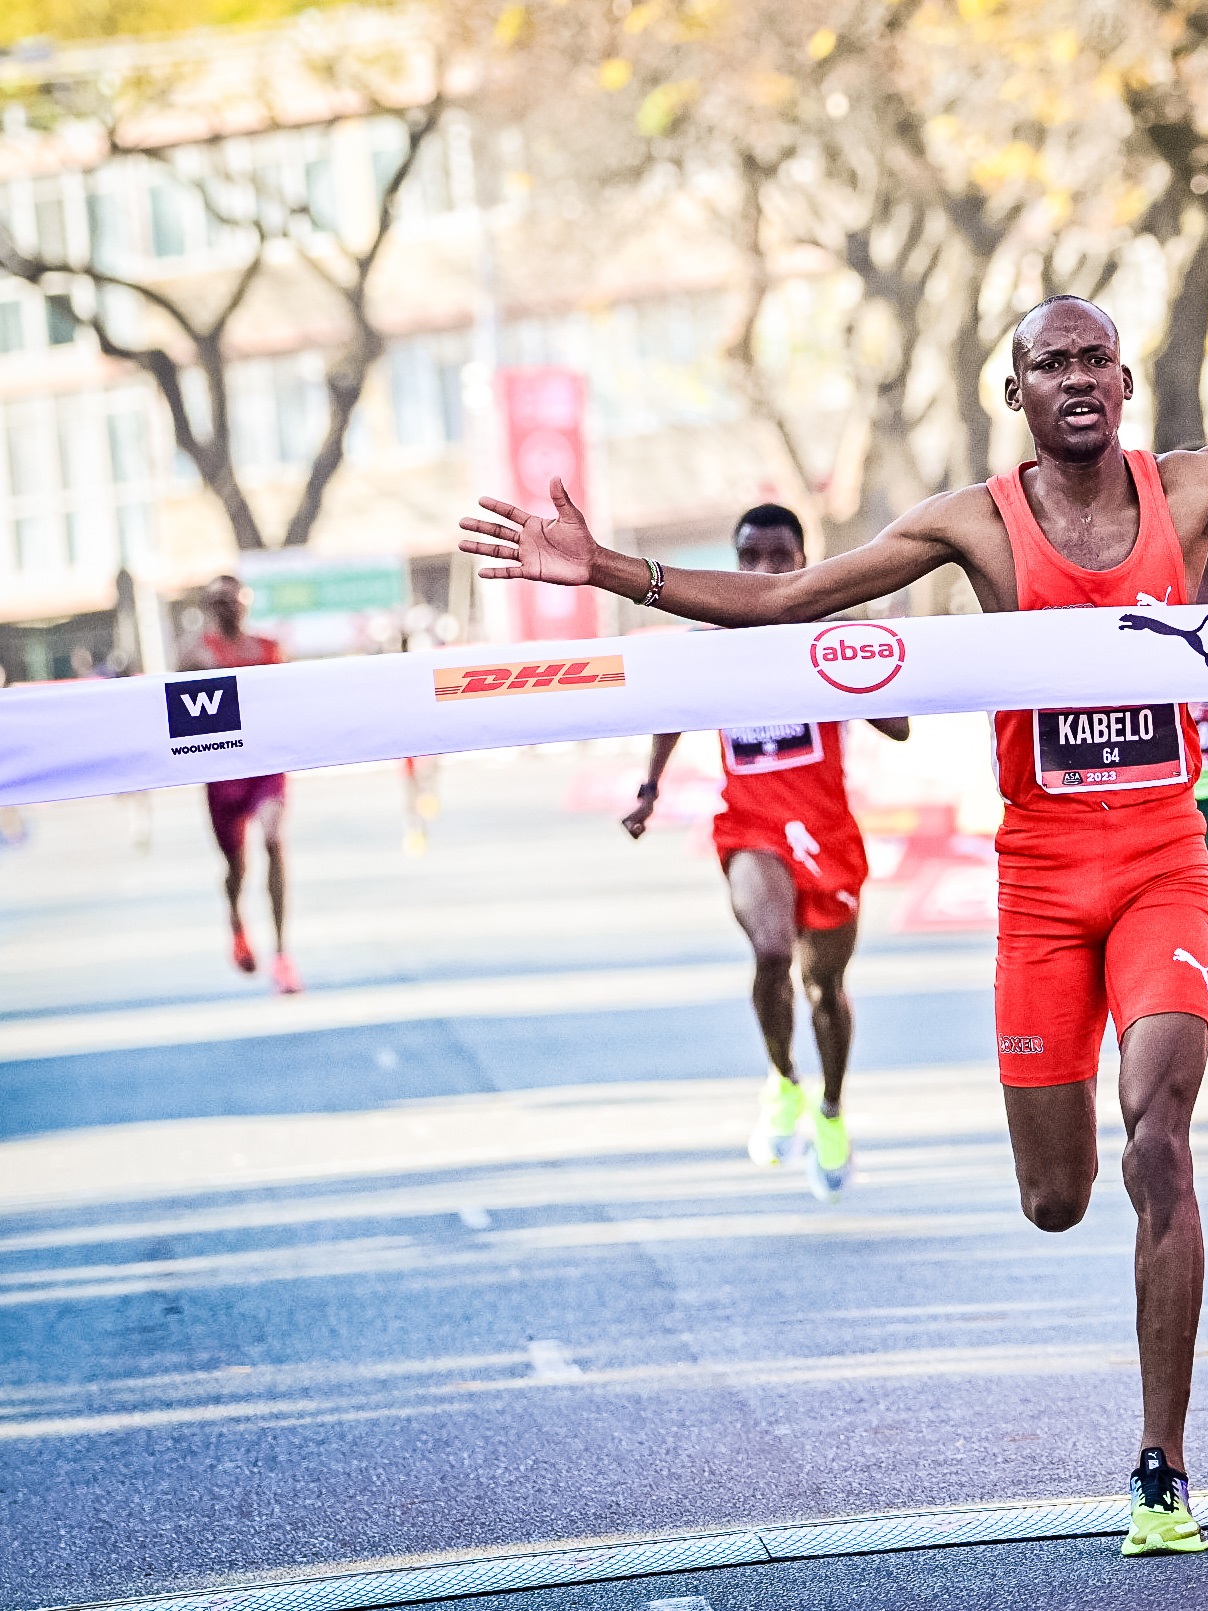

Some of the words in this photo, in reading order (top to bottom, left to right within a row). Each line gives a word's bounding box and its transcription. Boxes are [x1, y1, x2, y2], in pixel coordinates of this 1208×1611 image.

[822, 639, 895, 662] absa
[461, 661, 600, 694] DHL
[180, 689, 224, 717] W
[1058, 708, 1154, 745] KABELO
[170, 739, 244, 756] WOOLWORTHS
[1102, 747, 1120, 764] 64
[1064, 772, 1081, 781] ASA
[1086, 771, 1117, 782] 2023
[999, 1034, 1044, 1054] OXER
